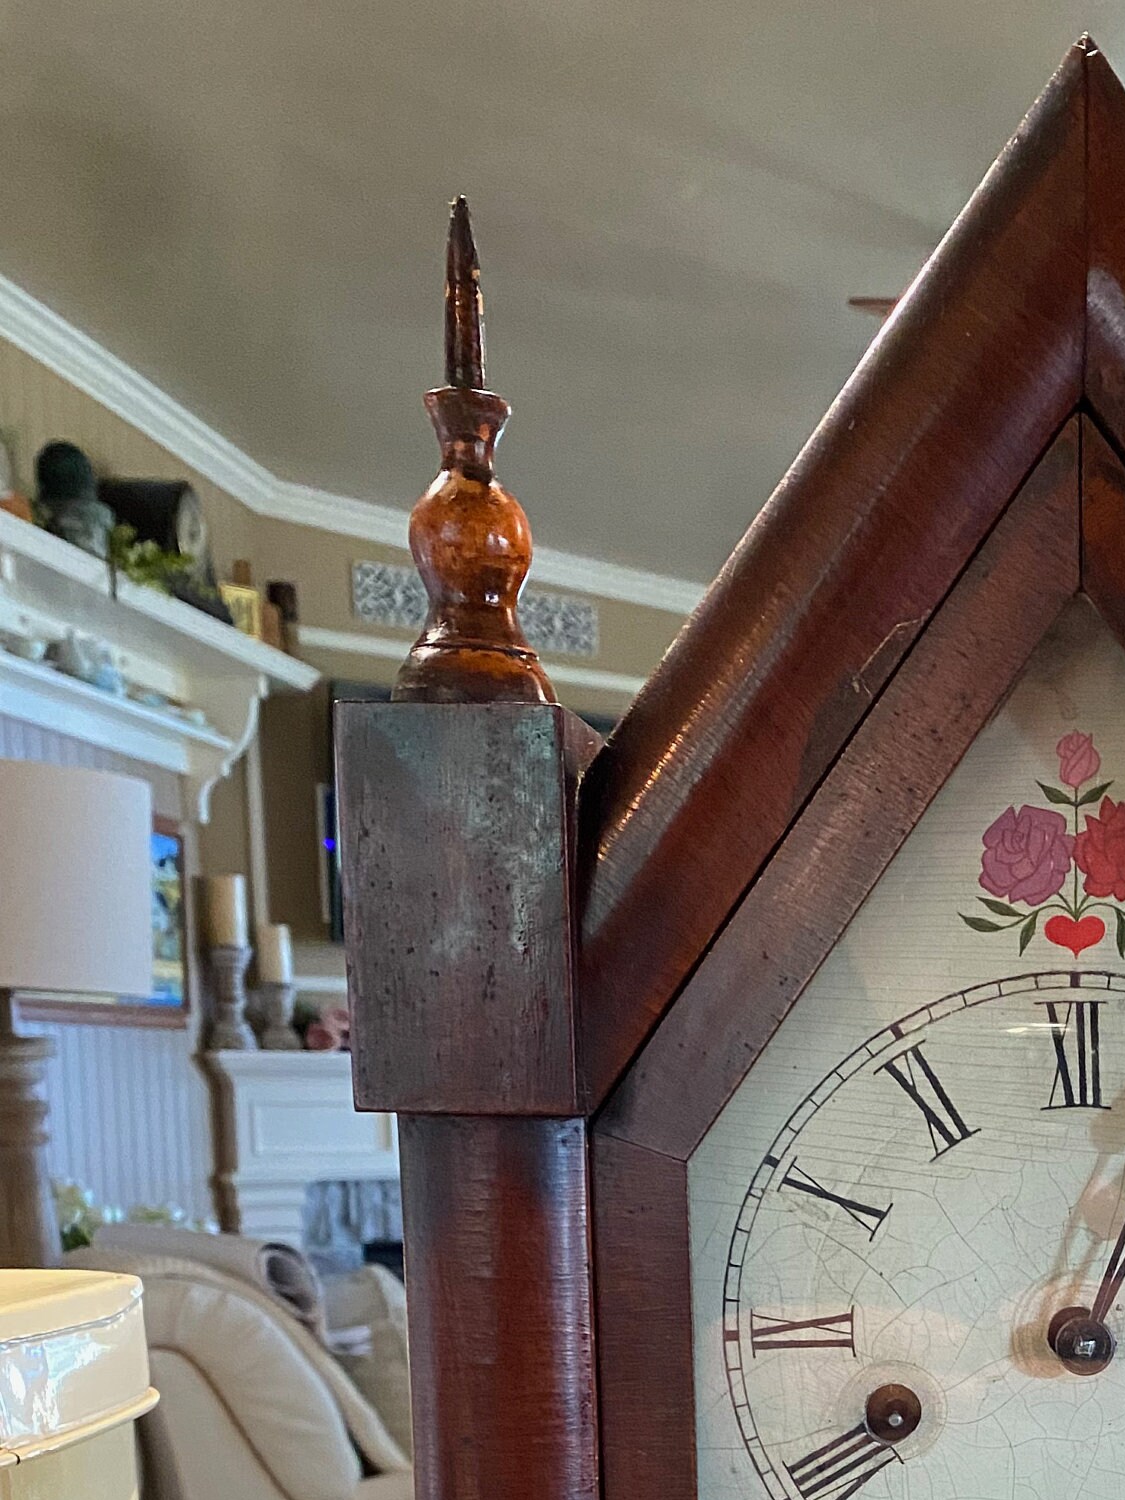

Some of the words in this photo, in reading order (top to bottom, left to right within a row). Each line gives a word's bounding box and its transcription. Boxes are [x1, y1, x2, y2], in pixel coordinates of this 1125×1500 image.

[873, 1039, 982, 1163] XI
[1034, 1000, 1112, 1111] XII
[777, 1155, 893, 1243] X
[750, 1305, 857, 1359] IX
